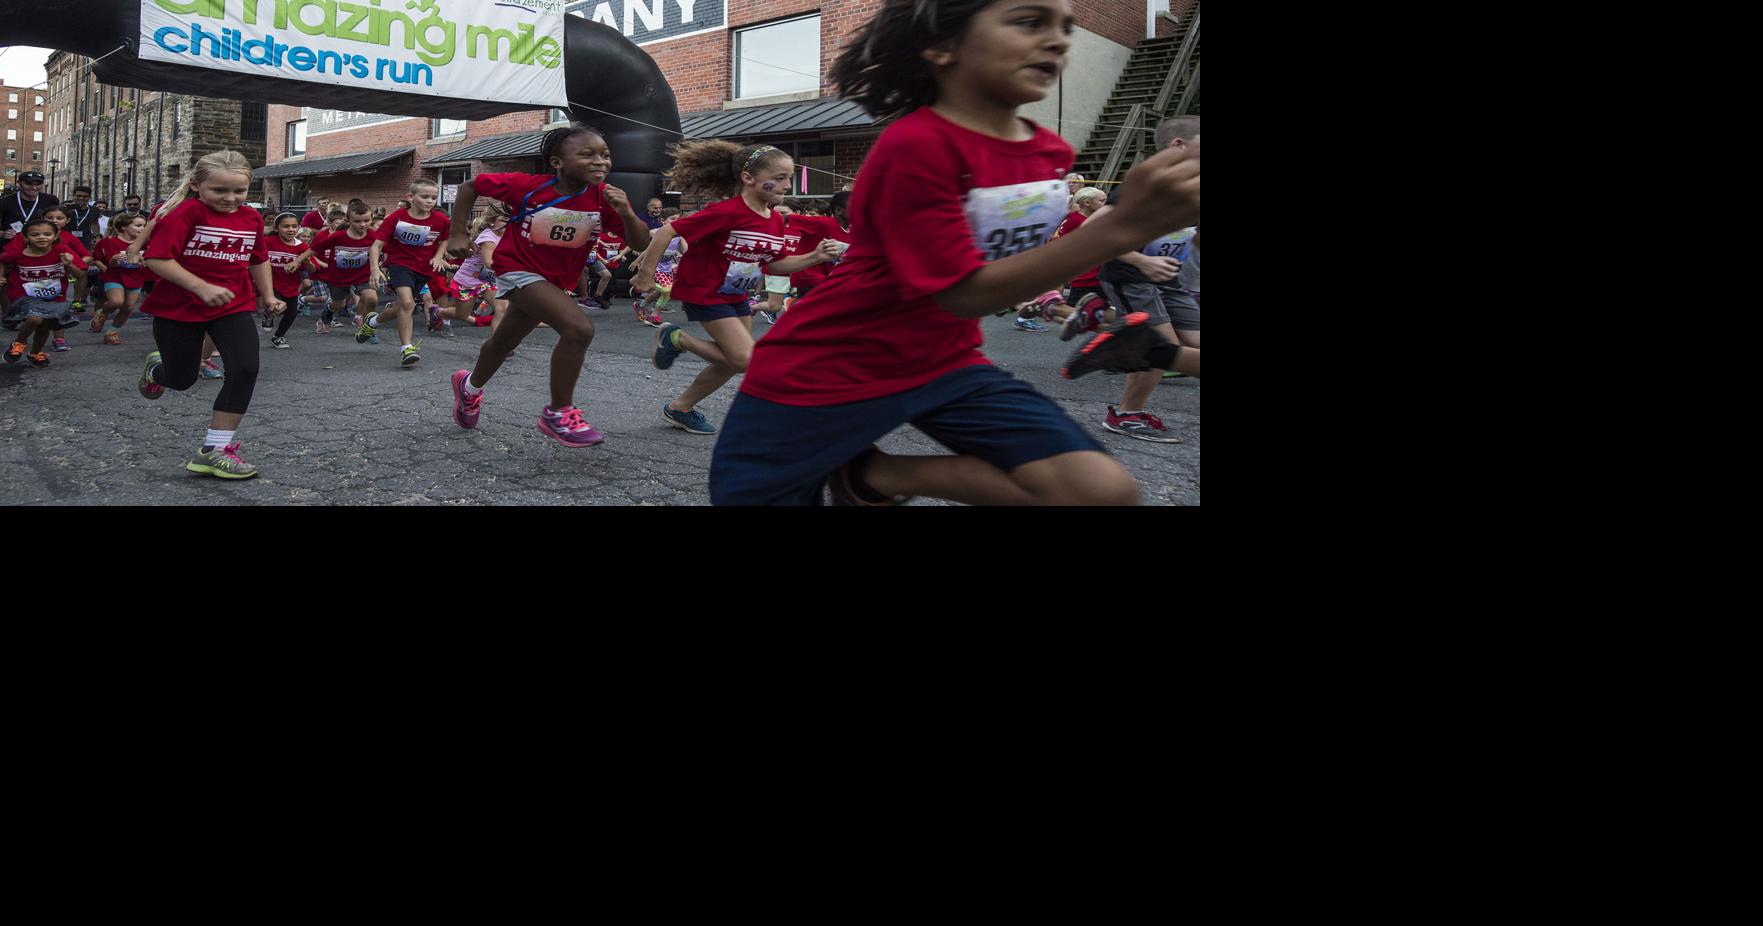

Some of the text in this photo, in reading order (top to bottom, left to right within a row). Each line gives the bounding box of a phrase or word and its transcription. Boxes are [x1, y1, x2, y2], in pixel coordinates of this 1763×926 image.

[566, 0, 700, 36] ANY
[466, 22, 561, 69] mile
[153, 23, 433, 86] children's run
[400, 231, 420, 241] 409
[550, 225, 576, 241] 63
[985, 223, 1048, 261] 355
[183, 249, 236, 262] amazing
[342, 258, 361, 266] 369
[34, 287, 57, 297] 388
